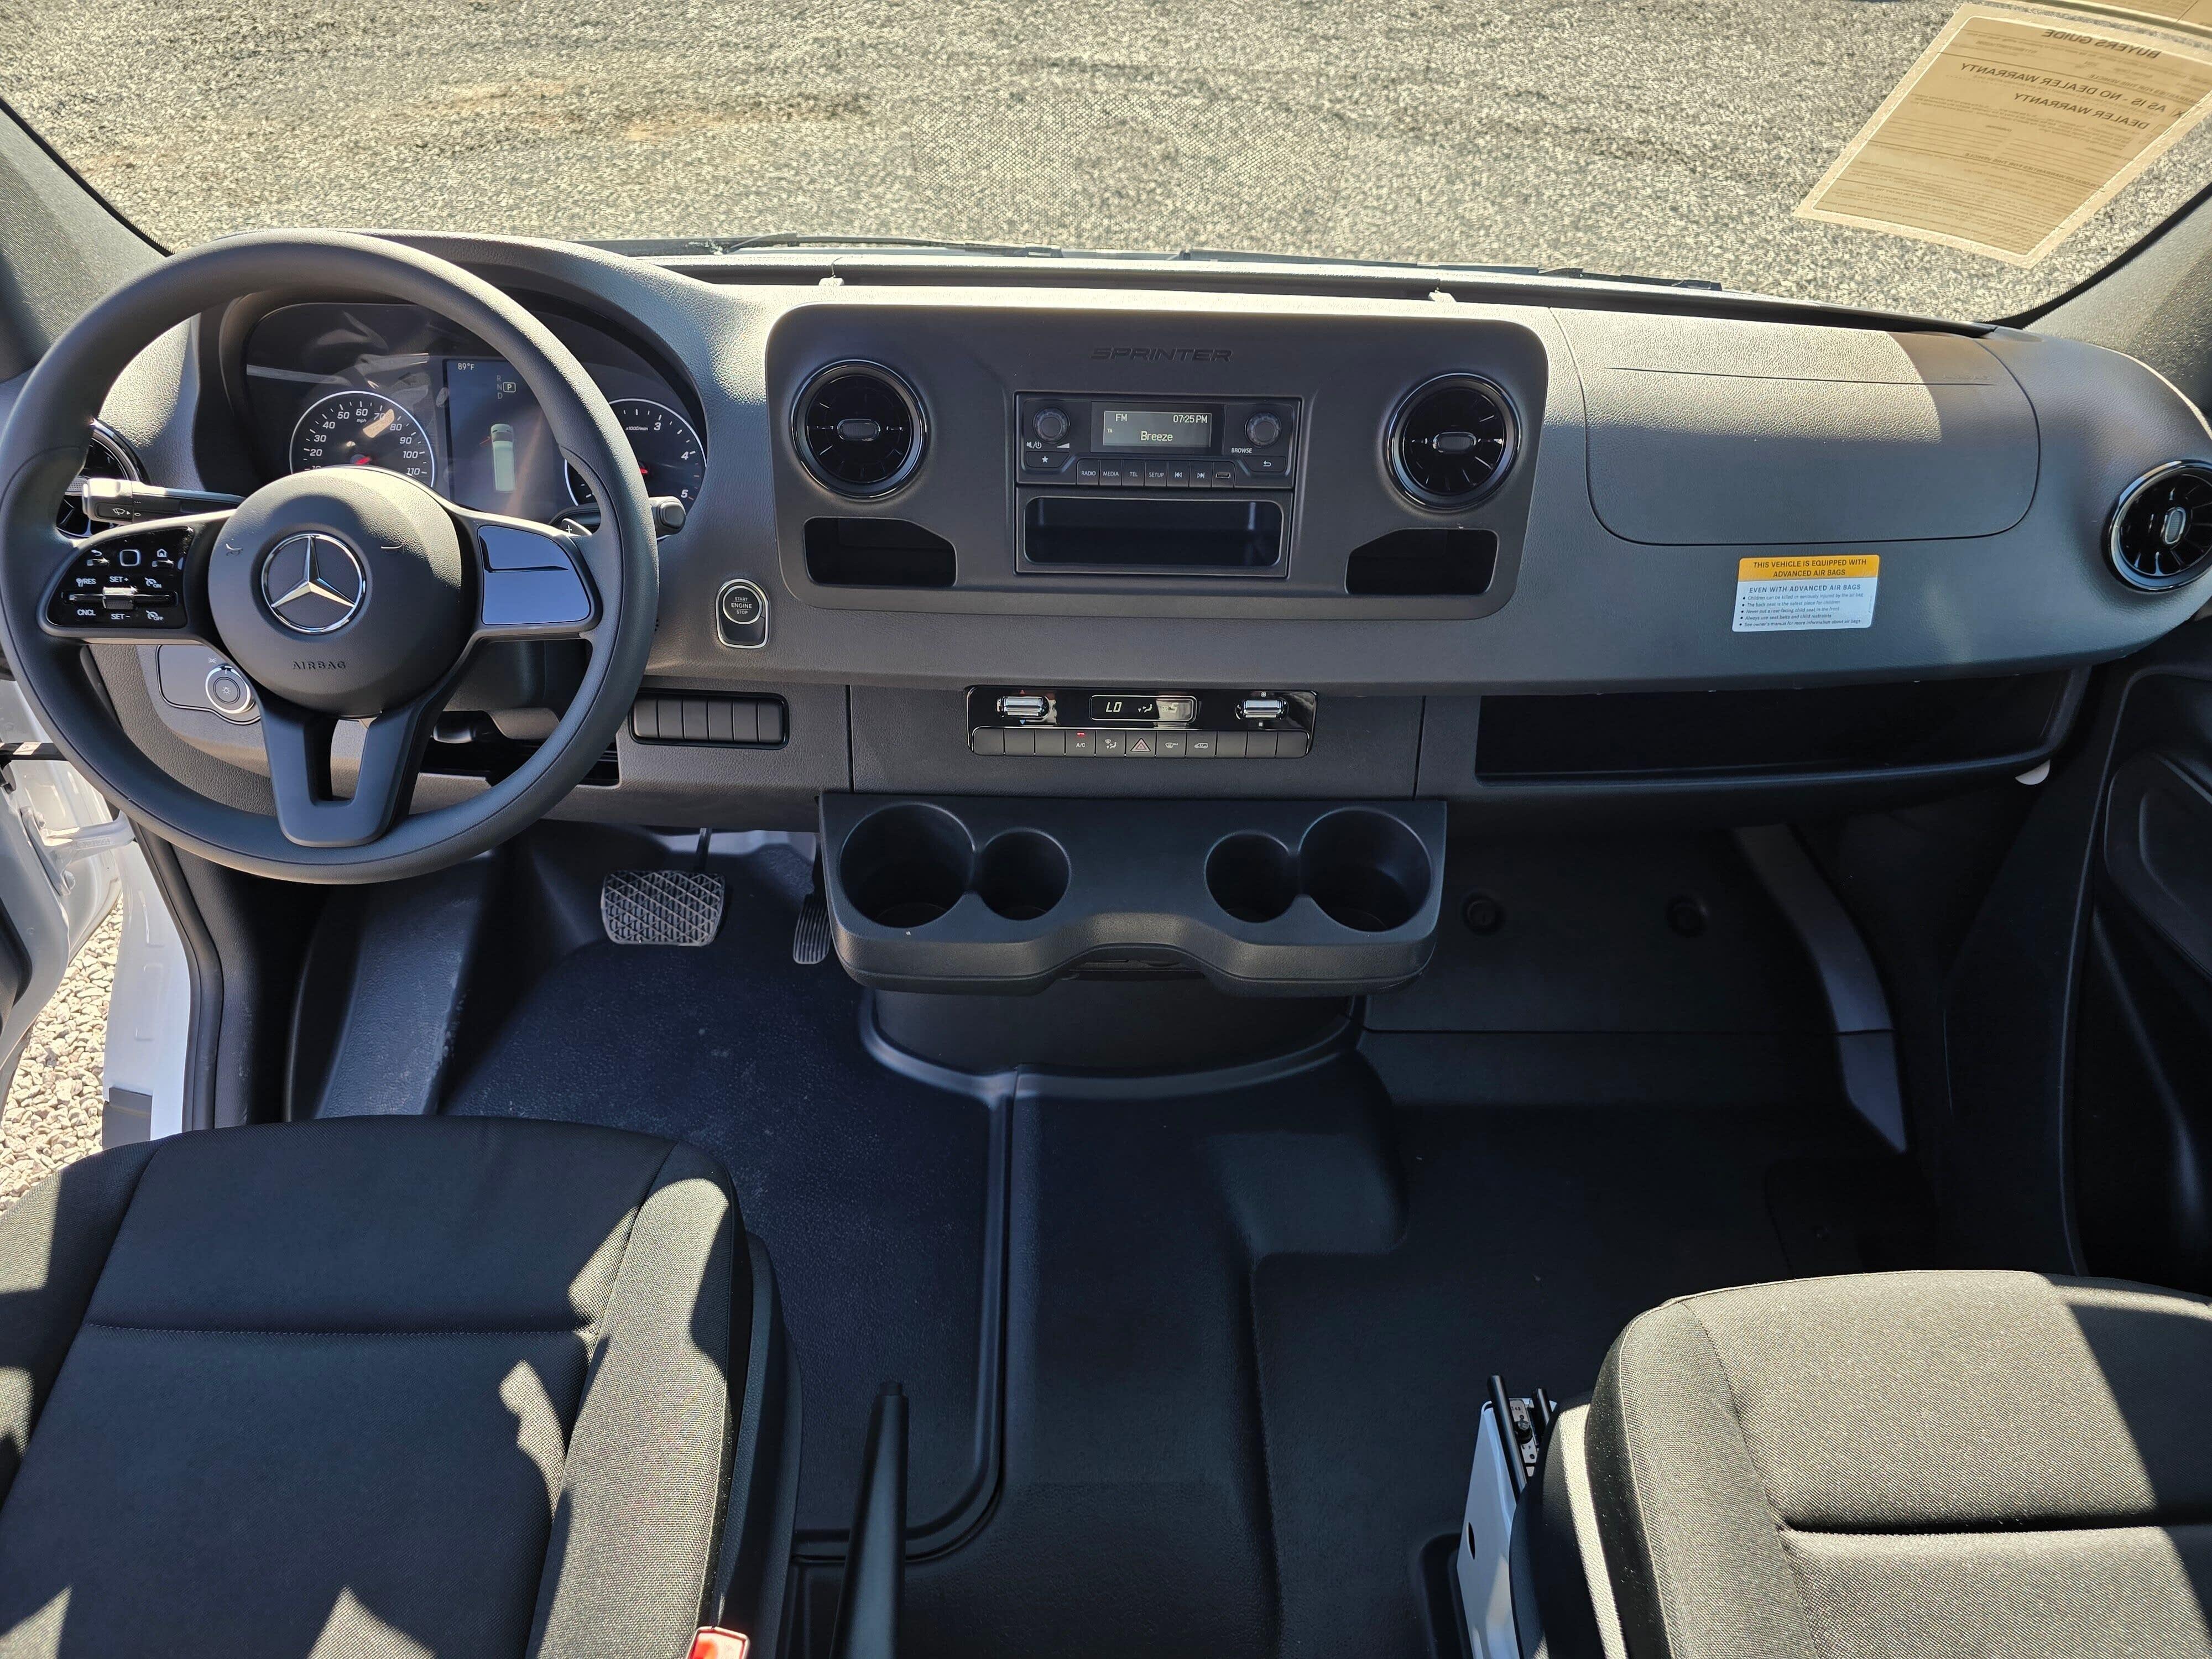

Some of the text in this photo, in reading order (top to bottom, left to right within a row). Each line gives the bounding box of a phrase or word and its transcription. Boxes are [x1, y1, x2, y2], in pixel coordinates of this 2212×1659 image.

[1090, 347, 1233, 361] SPRINTER
[1115, 413, 1208, 424] FM 07:25 PM
[654, 422, 661, 431] 3
[1141, 430, 1173, 441] Breeze
[681, 451, 689, 460] 4
[406, 467, 420, 476] 110
[680, 489, 688, 498] 5
[292, 661, 346, 670] AIRBAG
[1106, 701, 1122, 713] LO
